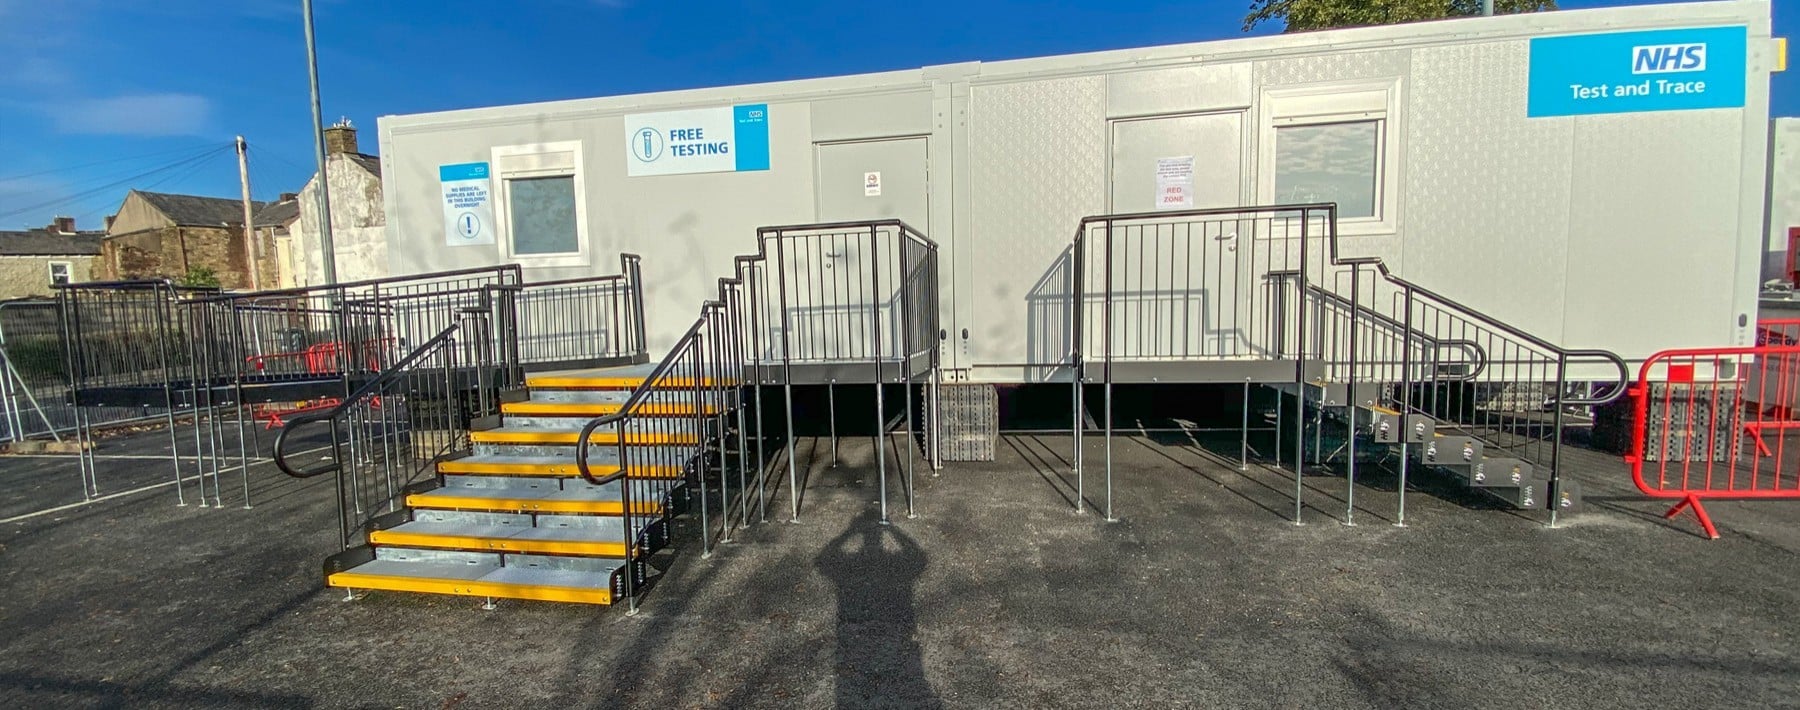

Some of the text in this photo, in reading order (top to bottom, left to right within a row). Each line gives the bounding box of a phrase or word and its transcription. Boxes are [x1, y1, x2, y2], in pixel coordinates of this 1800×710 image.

[1634, 44, 1703, 72] NHS
[1570, 79, 1706, 99] Test and Trace
[670, 128, 704, 141] FREE
[670, 142, 729, 156] TESTING
